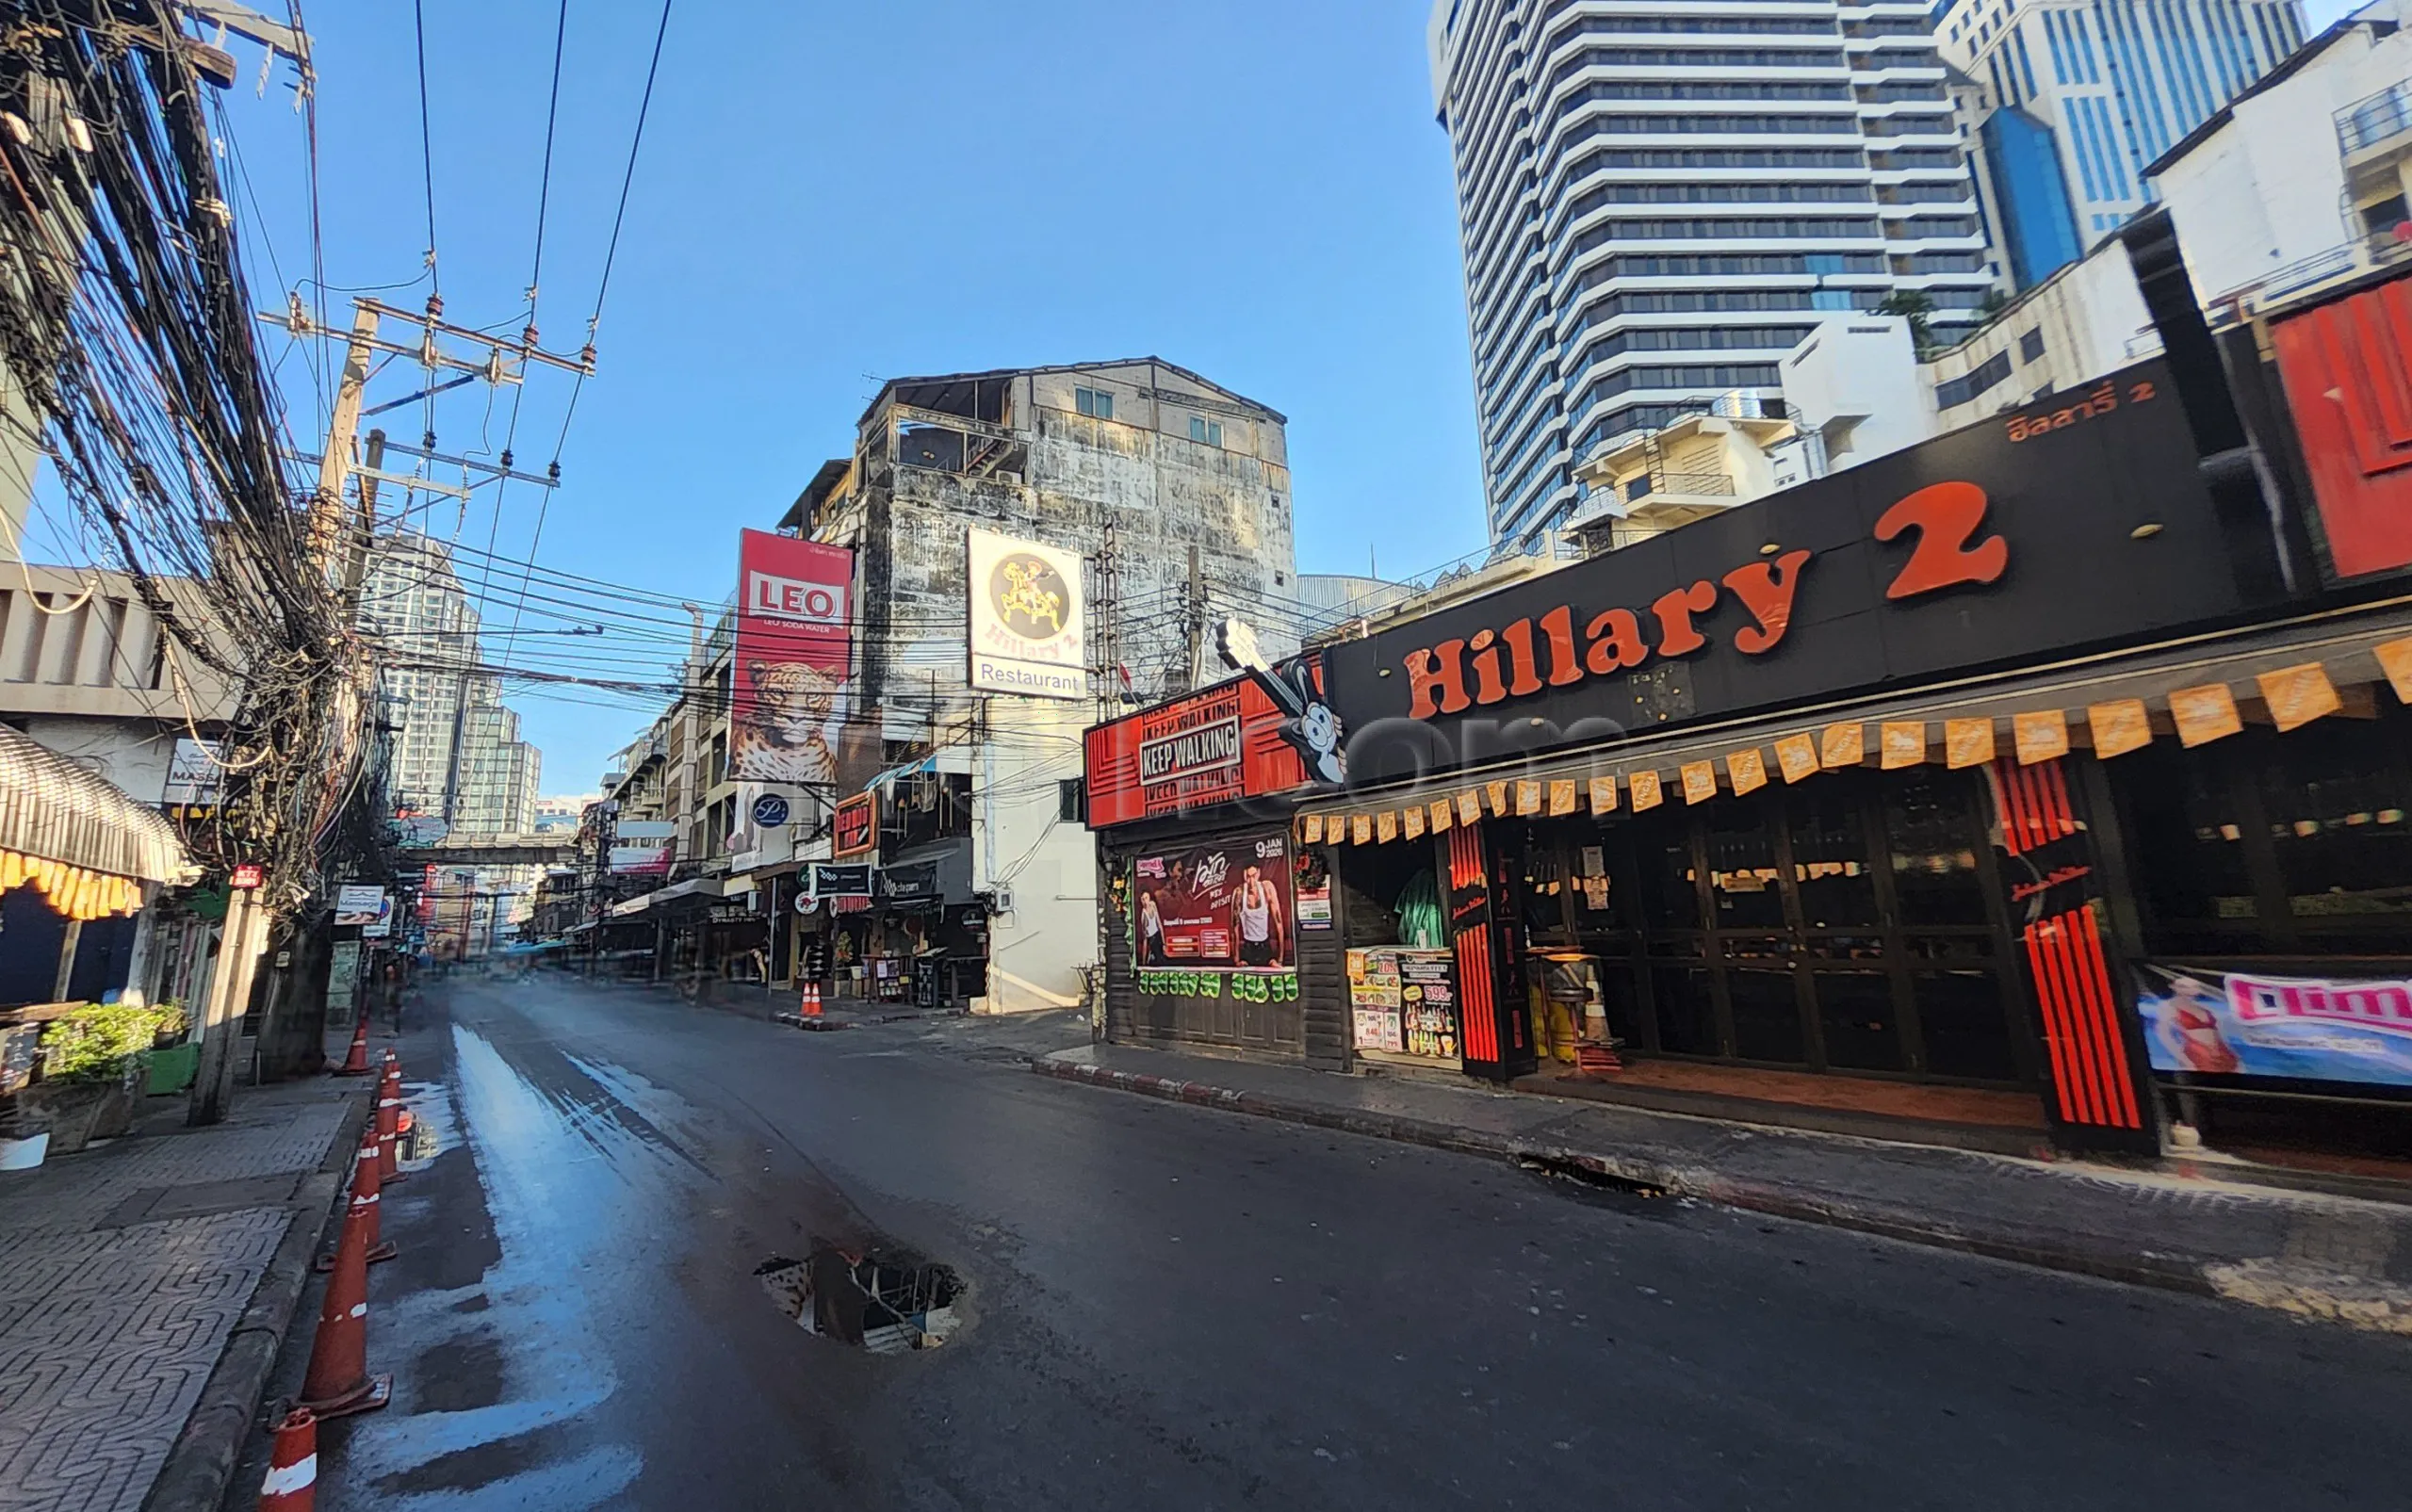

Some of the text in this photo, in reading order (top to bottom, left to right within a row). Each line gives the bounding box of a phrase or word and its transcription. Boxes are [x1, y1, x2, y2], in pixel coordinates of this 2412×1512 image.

[2128, 382, 2157, 403] 2
[759, 579, 836, 620] LEO
[1402, 480, 2010, 720] Hillary 2
[781, 621, 805, 630] SODA
[805, 623, 830, 634] WATER
[985, 623, 1078, 659] Hillary 2
[981, 663, 1079, 691] Restaurant
[1143, 724, 1235, 777] KEEP WALKING
[1255, 837, 1282, 858] 9 JAN
